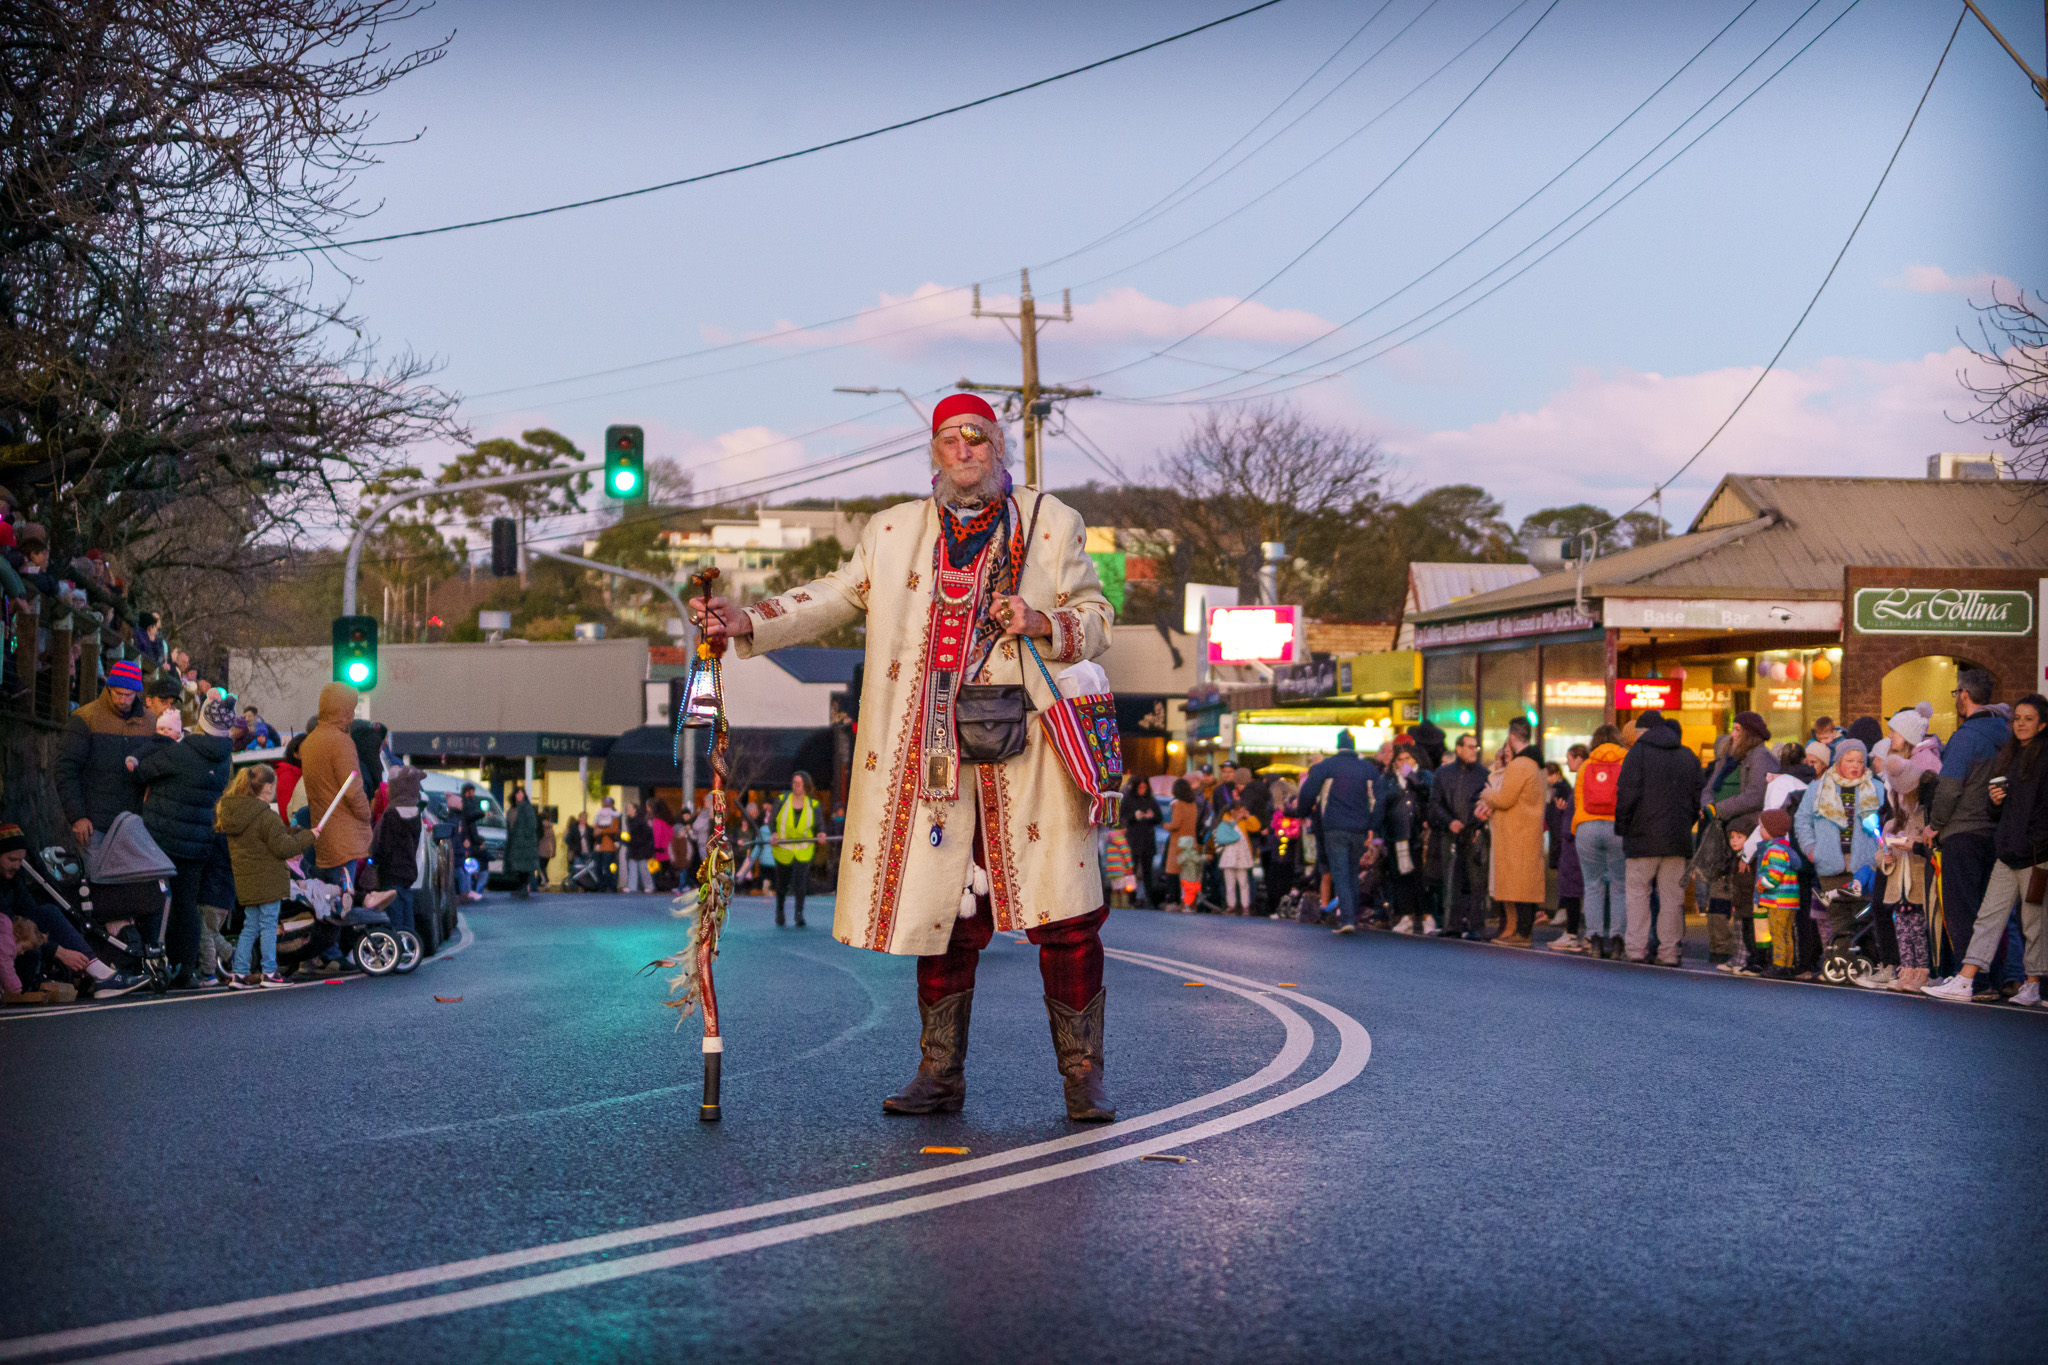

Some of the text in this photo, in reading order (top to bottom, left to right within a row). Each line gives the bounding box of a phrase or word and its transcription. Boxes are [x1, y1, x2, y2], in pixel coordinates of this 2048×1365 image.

[1873, 588, 2012, 621] La Collina
[1643, 609, 1685, 624] Base
[1721, 610, 1750, 625] Bar
[542, 737, 591, 752] RUSTIC
